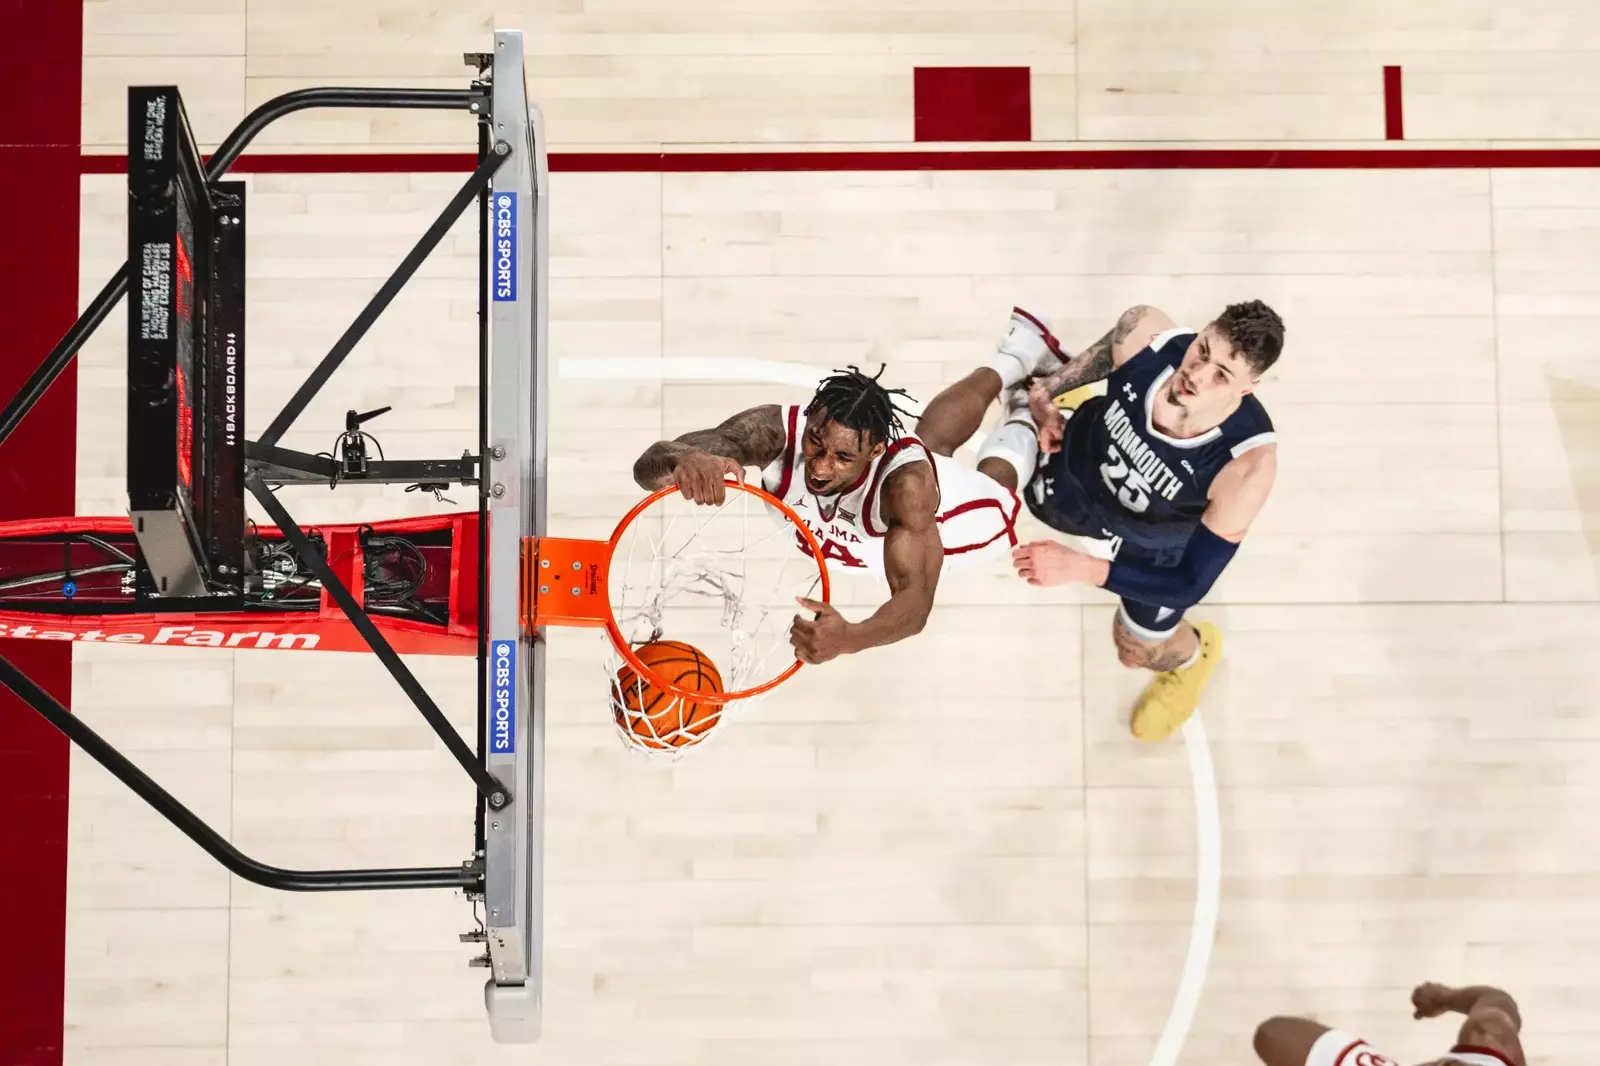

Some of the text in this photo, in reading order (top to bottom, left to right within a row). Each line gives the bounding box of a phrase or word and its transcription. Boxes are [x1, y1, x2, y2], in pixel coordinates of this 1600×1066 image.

[145, 119, 155, 141] ONLY
[146, 100, 156, 118] ONE
[153, 127, 163, 160] CAMERA
[151, 243, 161, 288] HARDWARE
[498, 208, 511, 297] CBS SPORTS
[141, 243, 152, 339] MAX WEIGHT OF CAMERA
[150, 289, 160, 331] MOUNTING
[160, 273, 169, 305] EXCEED
[159, 306, 168, 339] CANNOT
[226, 346, 236, 432] BACKBOARD
[1103, 400, 1184, 501] MONMOUTH
[1099, 444, 1153, 514] 25
[0, 623, 320, 649] tate Farm
[496, 657, 509, 749] CBS SPORTS
